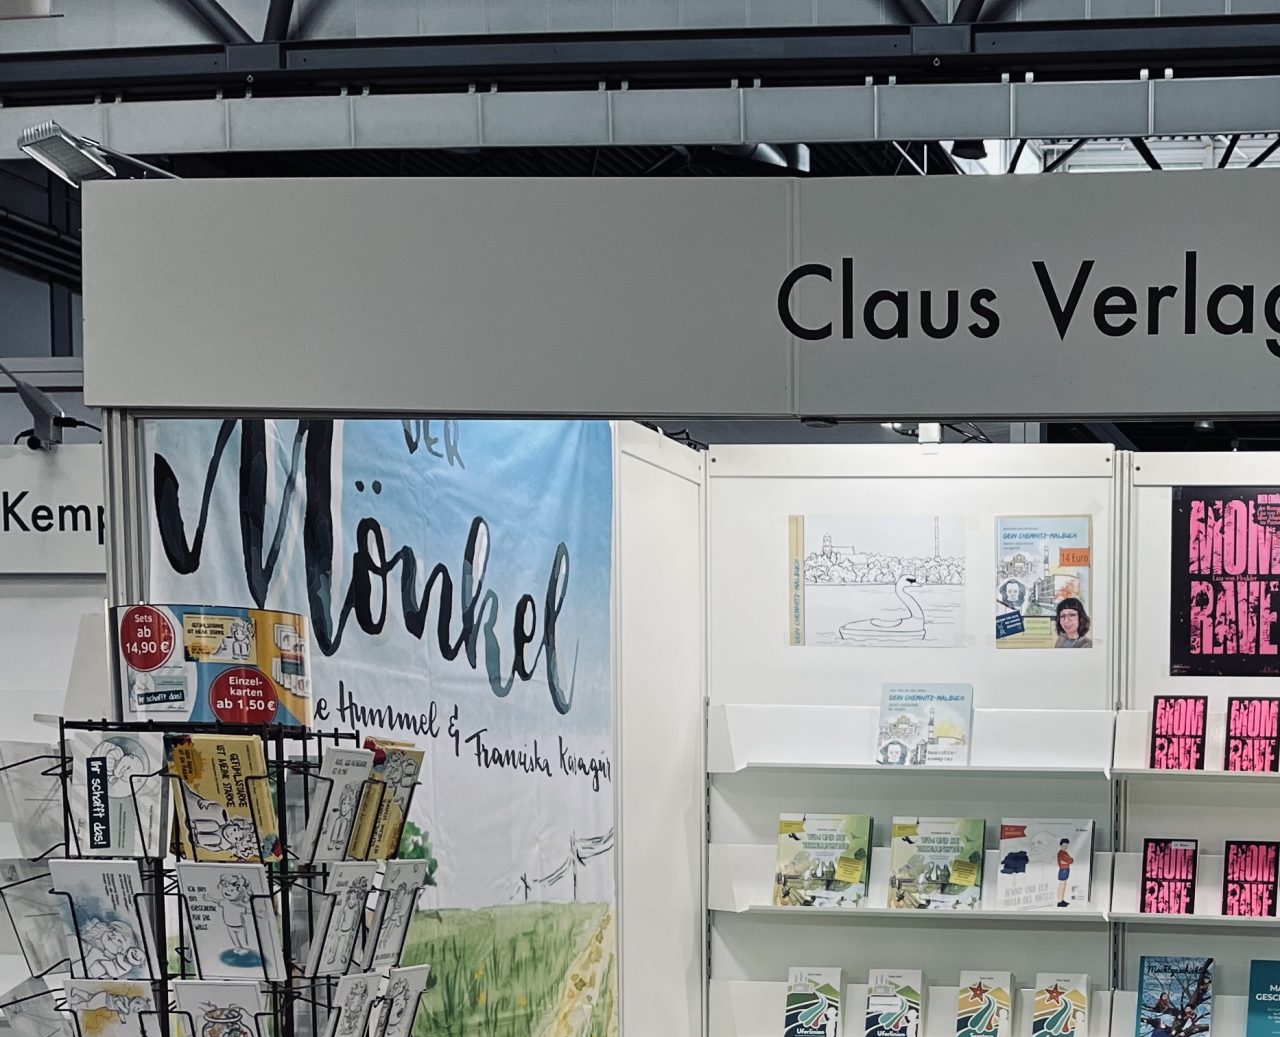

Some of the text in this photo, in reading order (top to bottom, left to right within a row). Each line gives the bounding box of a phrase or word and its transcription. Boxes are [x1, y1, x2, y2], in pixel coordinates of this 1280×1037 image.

[776, 257, 1000, 341] Claus
[1189, 499, 1280, 575] MOM
[153, 419, 582, 714] Mönkel
[1062, 552, 1089, 563] 14 Euro
[134, 614, 153, 624] Sets
[136, 626, 151, 639] ab
[1190, 580, 1279, 655] RAVE
[125, 641, 171, 655] 14,90 €
[229, 676, 263, 686] Einzel-
[229, 686, 263, 697] karten
[216, 699, 276, 710] ab 1,50 €
[1156, 698, 1205, 735] MOM
[1230, 700, 1279, 737] MOM
[1155, 737, 1201, 769] RAVE
[1229, 739, 1277, 772] RAVE
[91, 778, 107, 846] schafft das!
[1228, 845, 1276, 882] MOM
